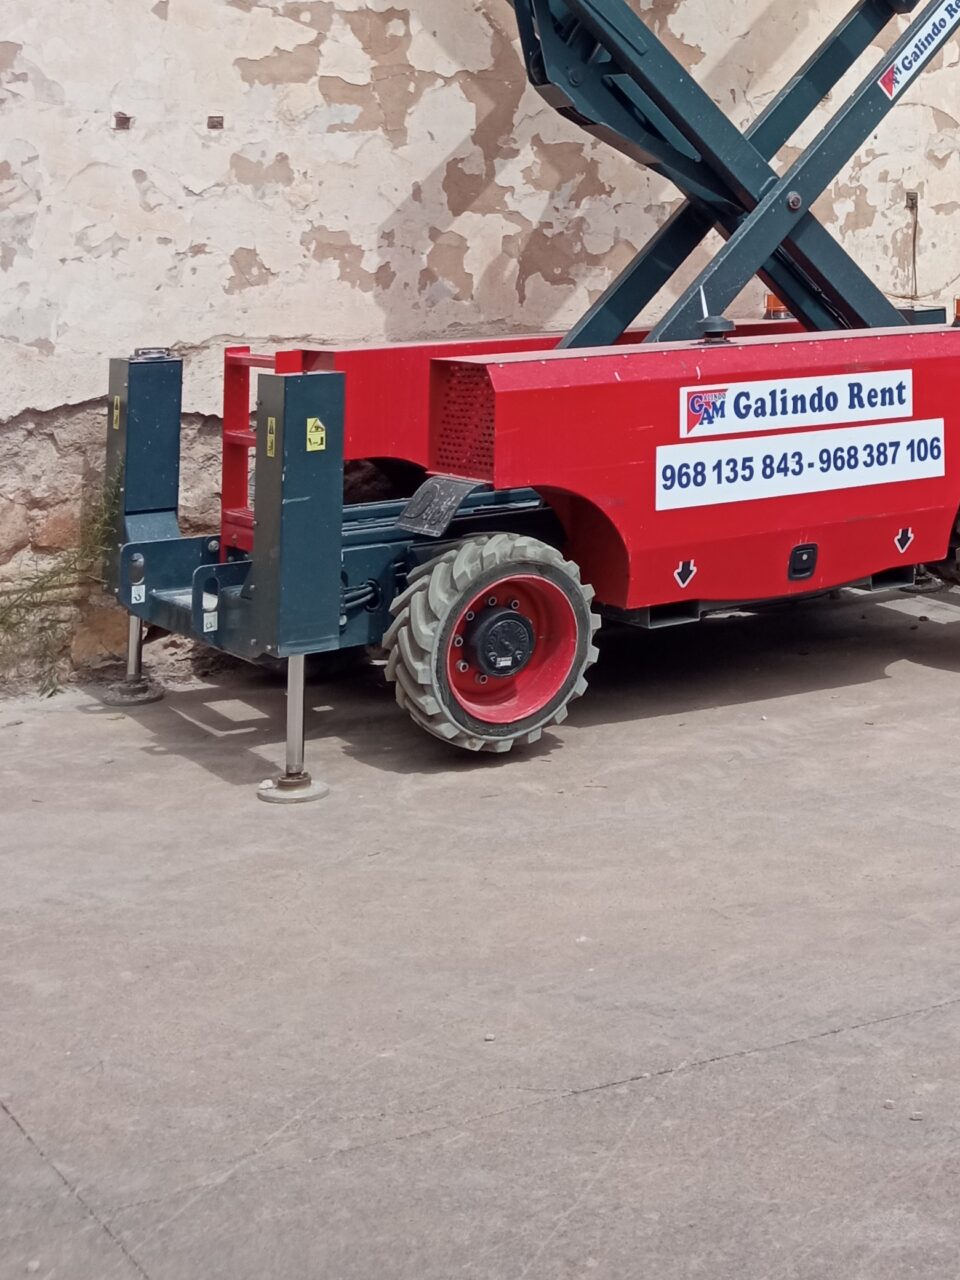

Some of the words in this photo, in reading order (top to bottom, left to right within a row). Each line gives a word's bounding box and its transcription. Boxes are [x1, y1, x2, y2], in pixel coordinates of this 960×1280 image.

[901, 17, 947, 71] Galindo
[733, 385, 839, 420] Galindo
[848, 381, 906, 410] Rent
[662, 461, 707, 490] 968
[712, 456, 754, 484] 135
[862, 440, 901, 468] 387
[906, 436, 941, 463] 106
